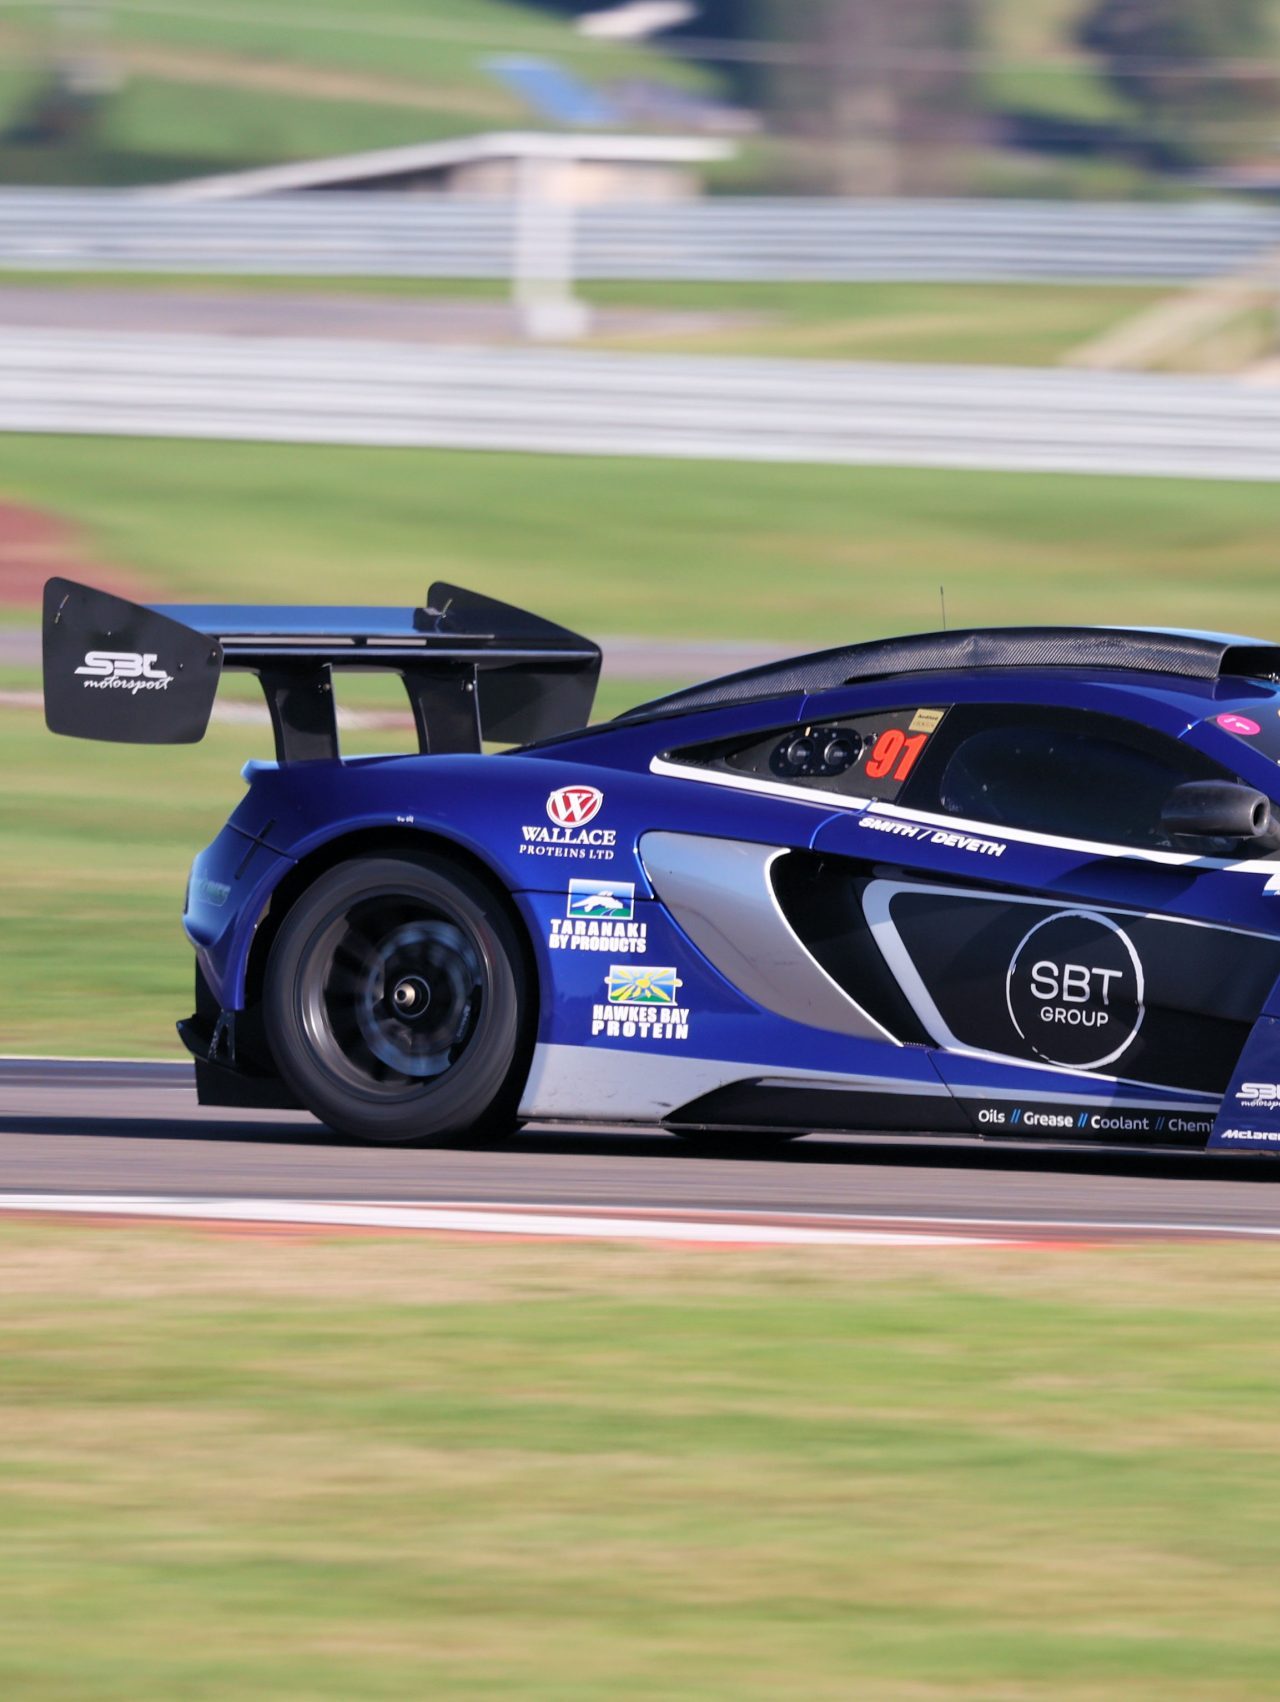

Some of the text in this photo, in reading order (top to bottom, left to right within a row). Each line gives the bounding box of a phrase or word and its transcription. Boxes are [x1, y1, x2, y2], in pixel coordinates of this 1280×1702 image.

[84, 675, 174, 695] motorsport
[864, 729, 928, 781] 91
[522, 826, 616, 846] WALLACE
[858, 817, 920, 838] SMITH
[930, 831, 1006, 857] DEVETH
[519, 844, 615, 860] PROTEINS LTD
[550, 919, 647, 938] TARANAKI
[549, 933, 647, 953] BY PRODUCTS
[1030, 960, 1123, 1005] SBT
[592, 1004, 689, 1024] HAWKES BAY
[1040, 1006, 1109, 1027] GROUP
[592, 1020, 689, 1039] PROTEIN
[978, 1109, 1005, 1123] Oils
[1023, 1111, 1073, 1127] Grease
[1091, 1115, 1149, 1130] Coolant
